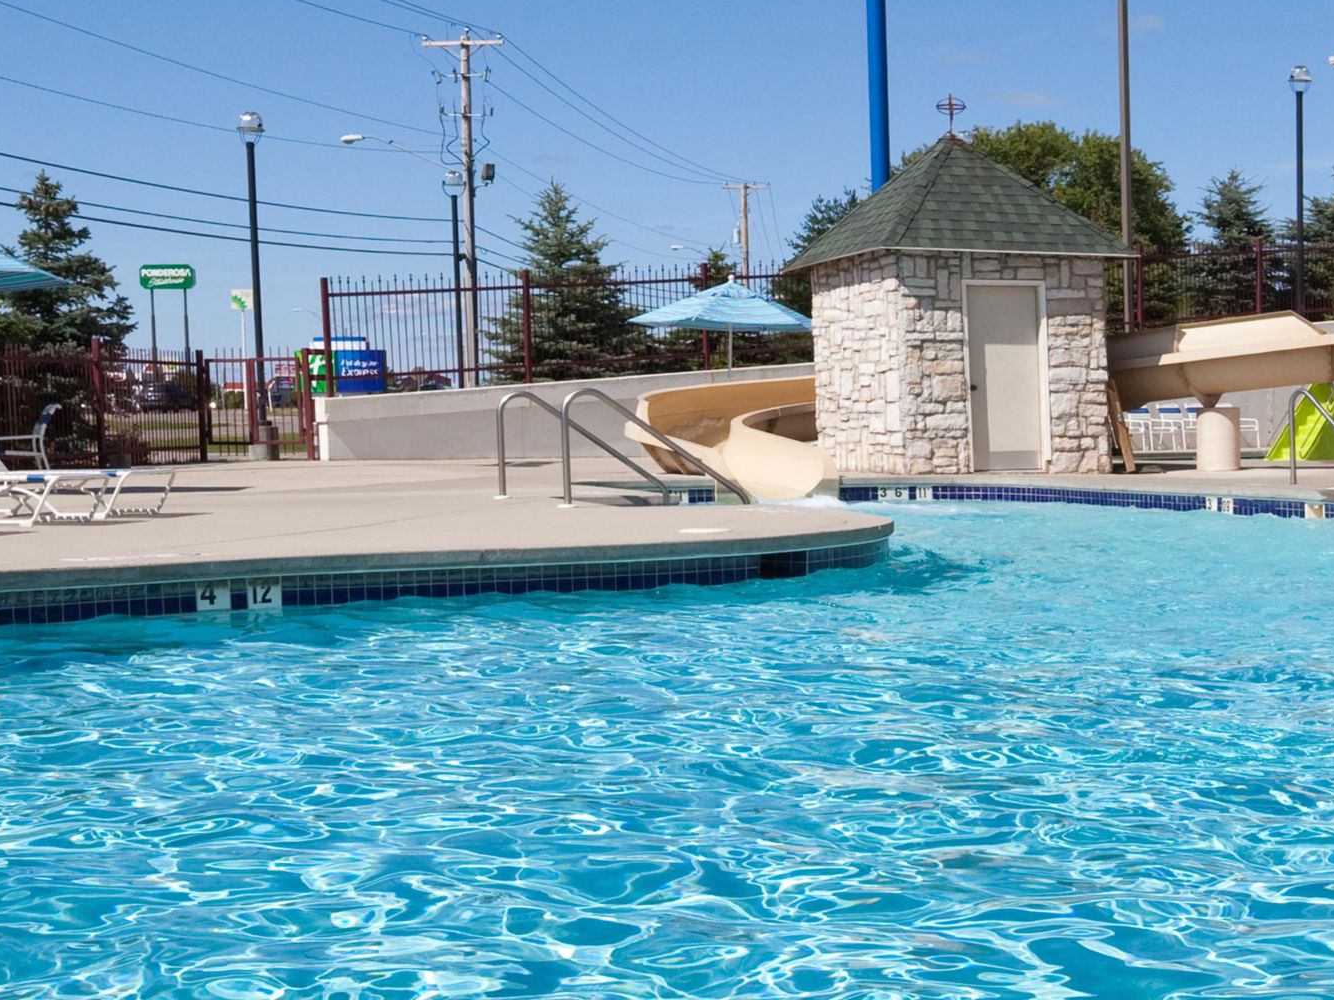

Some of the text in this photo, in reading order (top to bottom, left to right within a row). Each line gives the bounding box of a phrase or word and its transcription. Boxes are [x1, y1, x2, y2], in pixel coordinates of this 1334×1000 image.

[141, 268, 191, 277] PONDEROSA
[880, 487, 887, 498] 3
[895, 487, 902, 498] 6
[200, 580, 217, 605] 4
